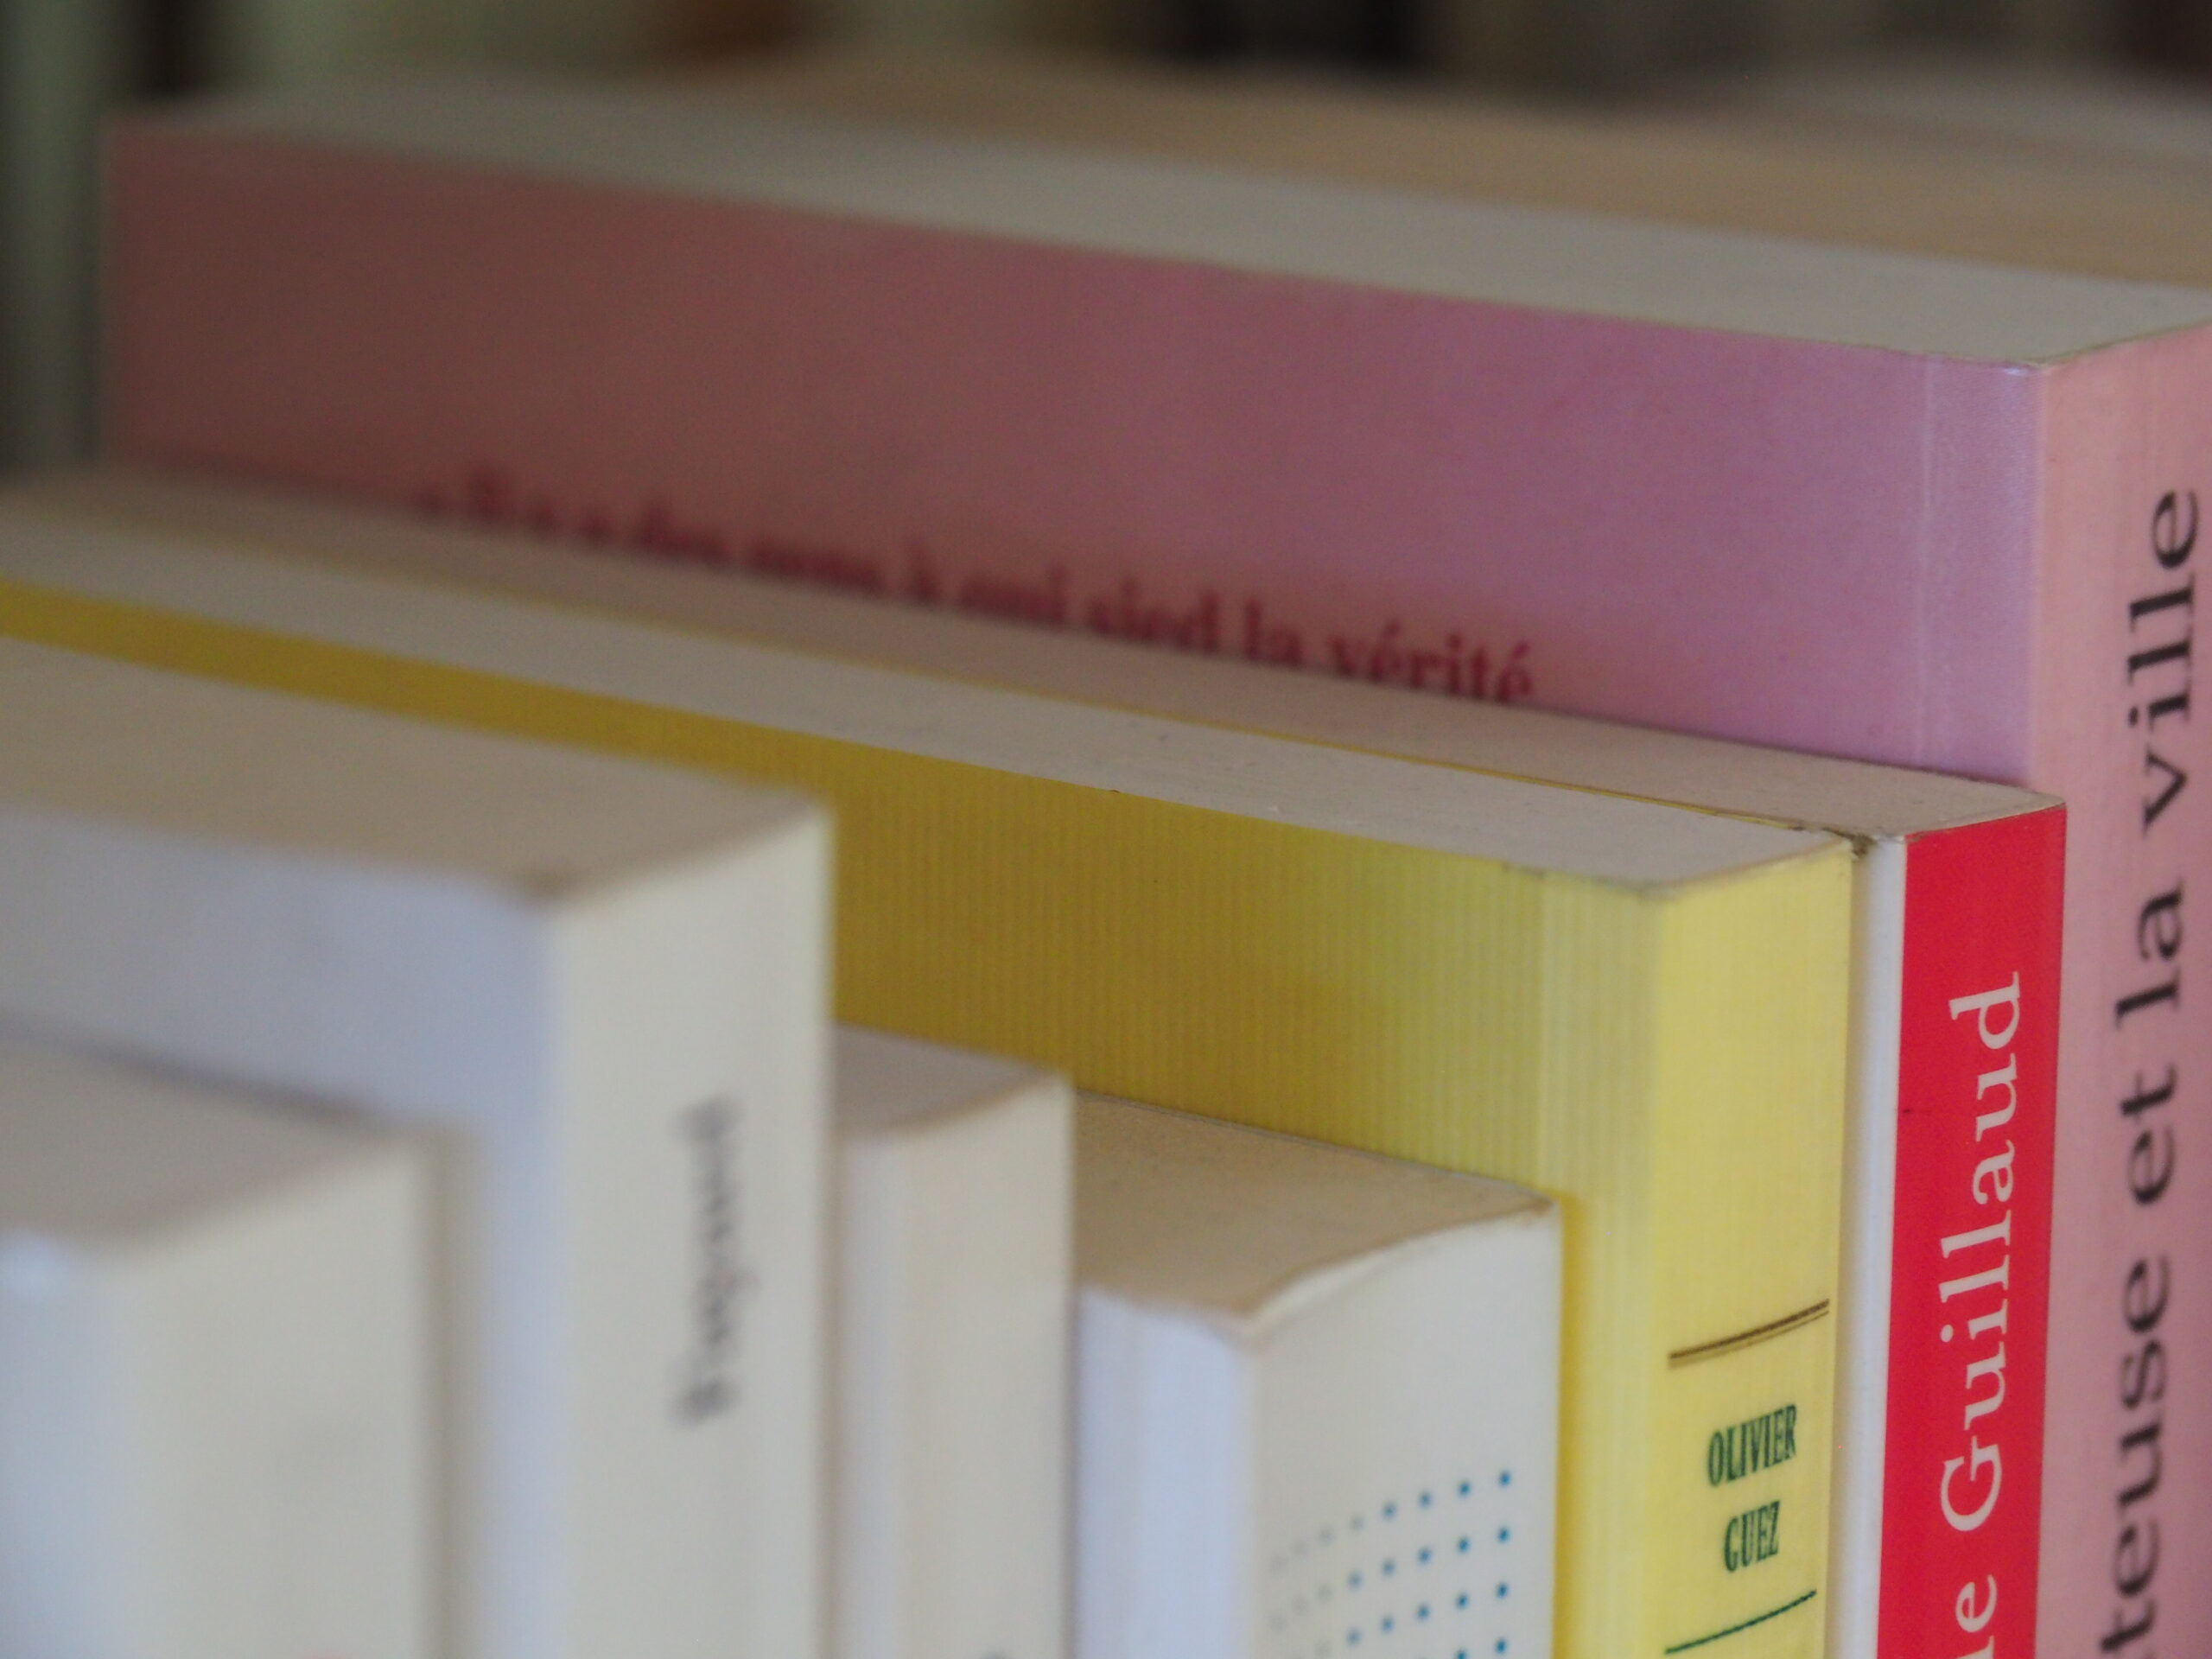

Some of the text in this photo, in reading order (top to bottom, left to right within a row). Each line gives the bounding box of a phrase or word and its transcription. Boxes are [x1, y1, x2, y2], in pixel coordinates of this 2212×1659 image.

[1332, 617, 1533, 706] vérité
[2100, 488, 2199, 1659] teuse et la ville
[1939, 970, 2020, 1533] Guillaud
[1707, 1403, 1797, 1487] OLIVIER
[1724, 1500, 1781, 1573] GUEZ
